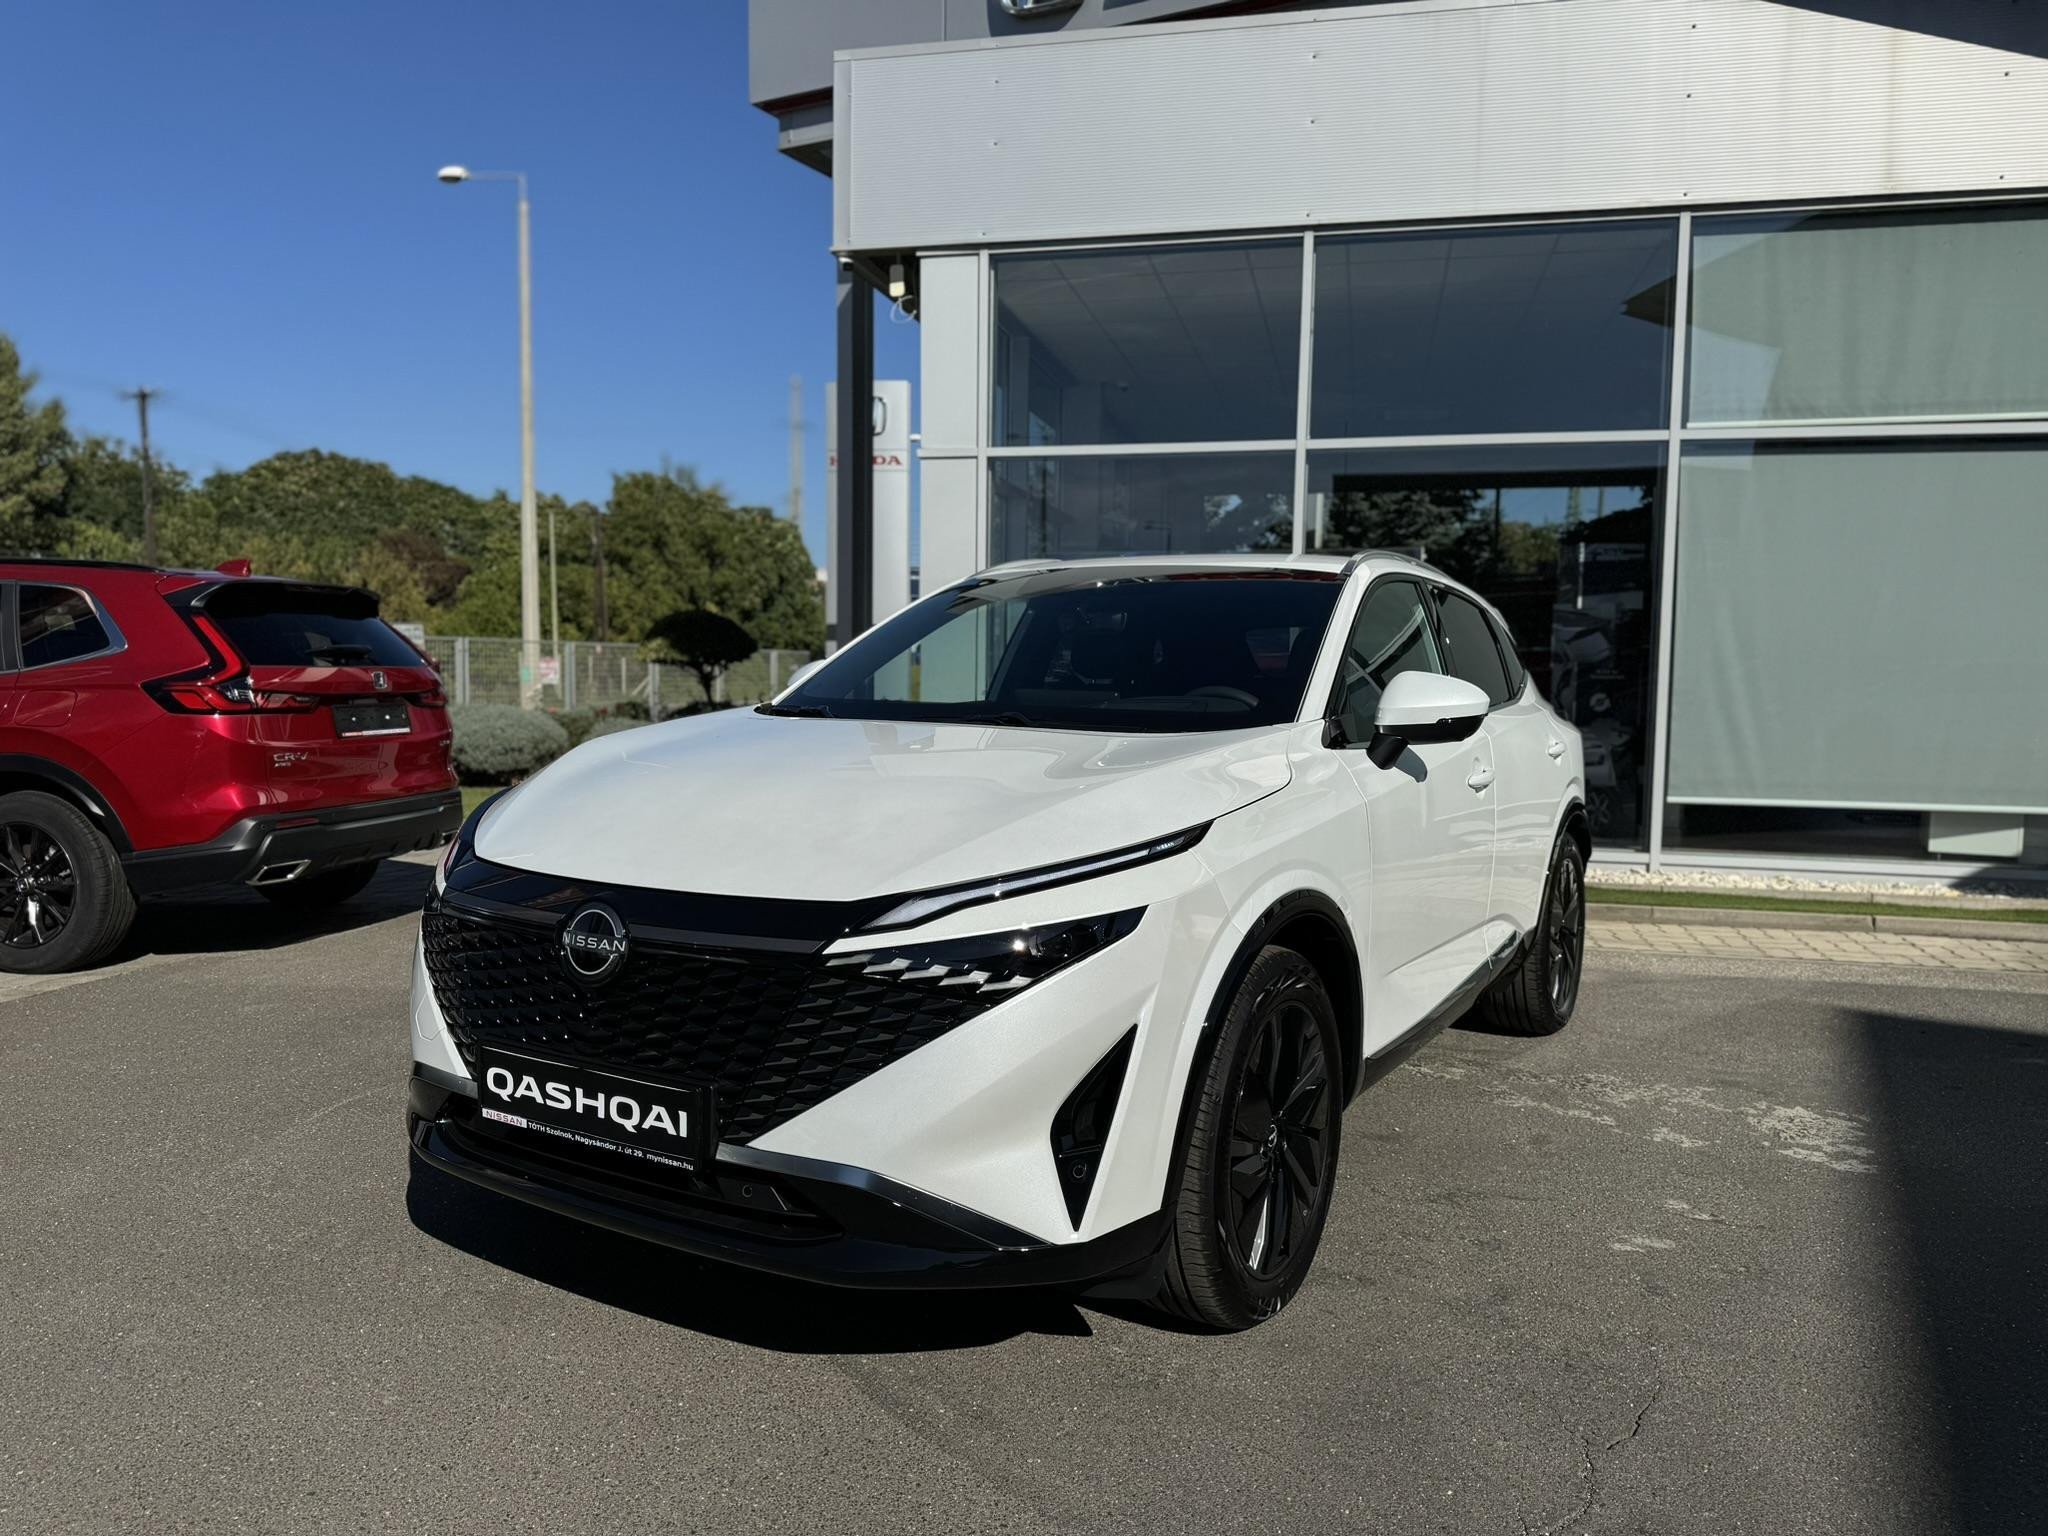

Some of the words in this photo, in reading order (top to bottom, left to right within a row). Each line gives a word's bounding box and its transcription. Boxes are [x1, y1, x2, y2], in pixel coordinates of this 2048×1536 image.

[829, 455, 902, 466] HDA
[563, 931, 626, 952] NISSAN
[486, 1067, 688, 1138] QASHQAI
[486, 1110, 523, 1126] NISSAN
[528, 1121, 546, 1132] TÓTH
[546, 1127, 575, 1141] Szolnok,
[575, 1134, 616, 1151] Nagysándor
[633, 1149, 644, 1158] 29.
[646, 1153, 694, 1171] mynissan.hu
